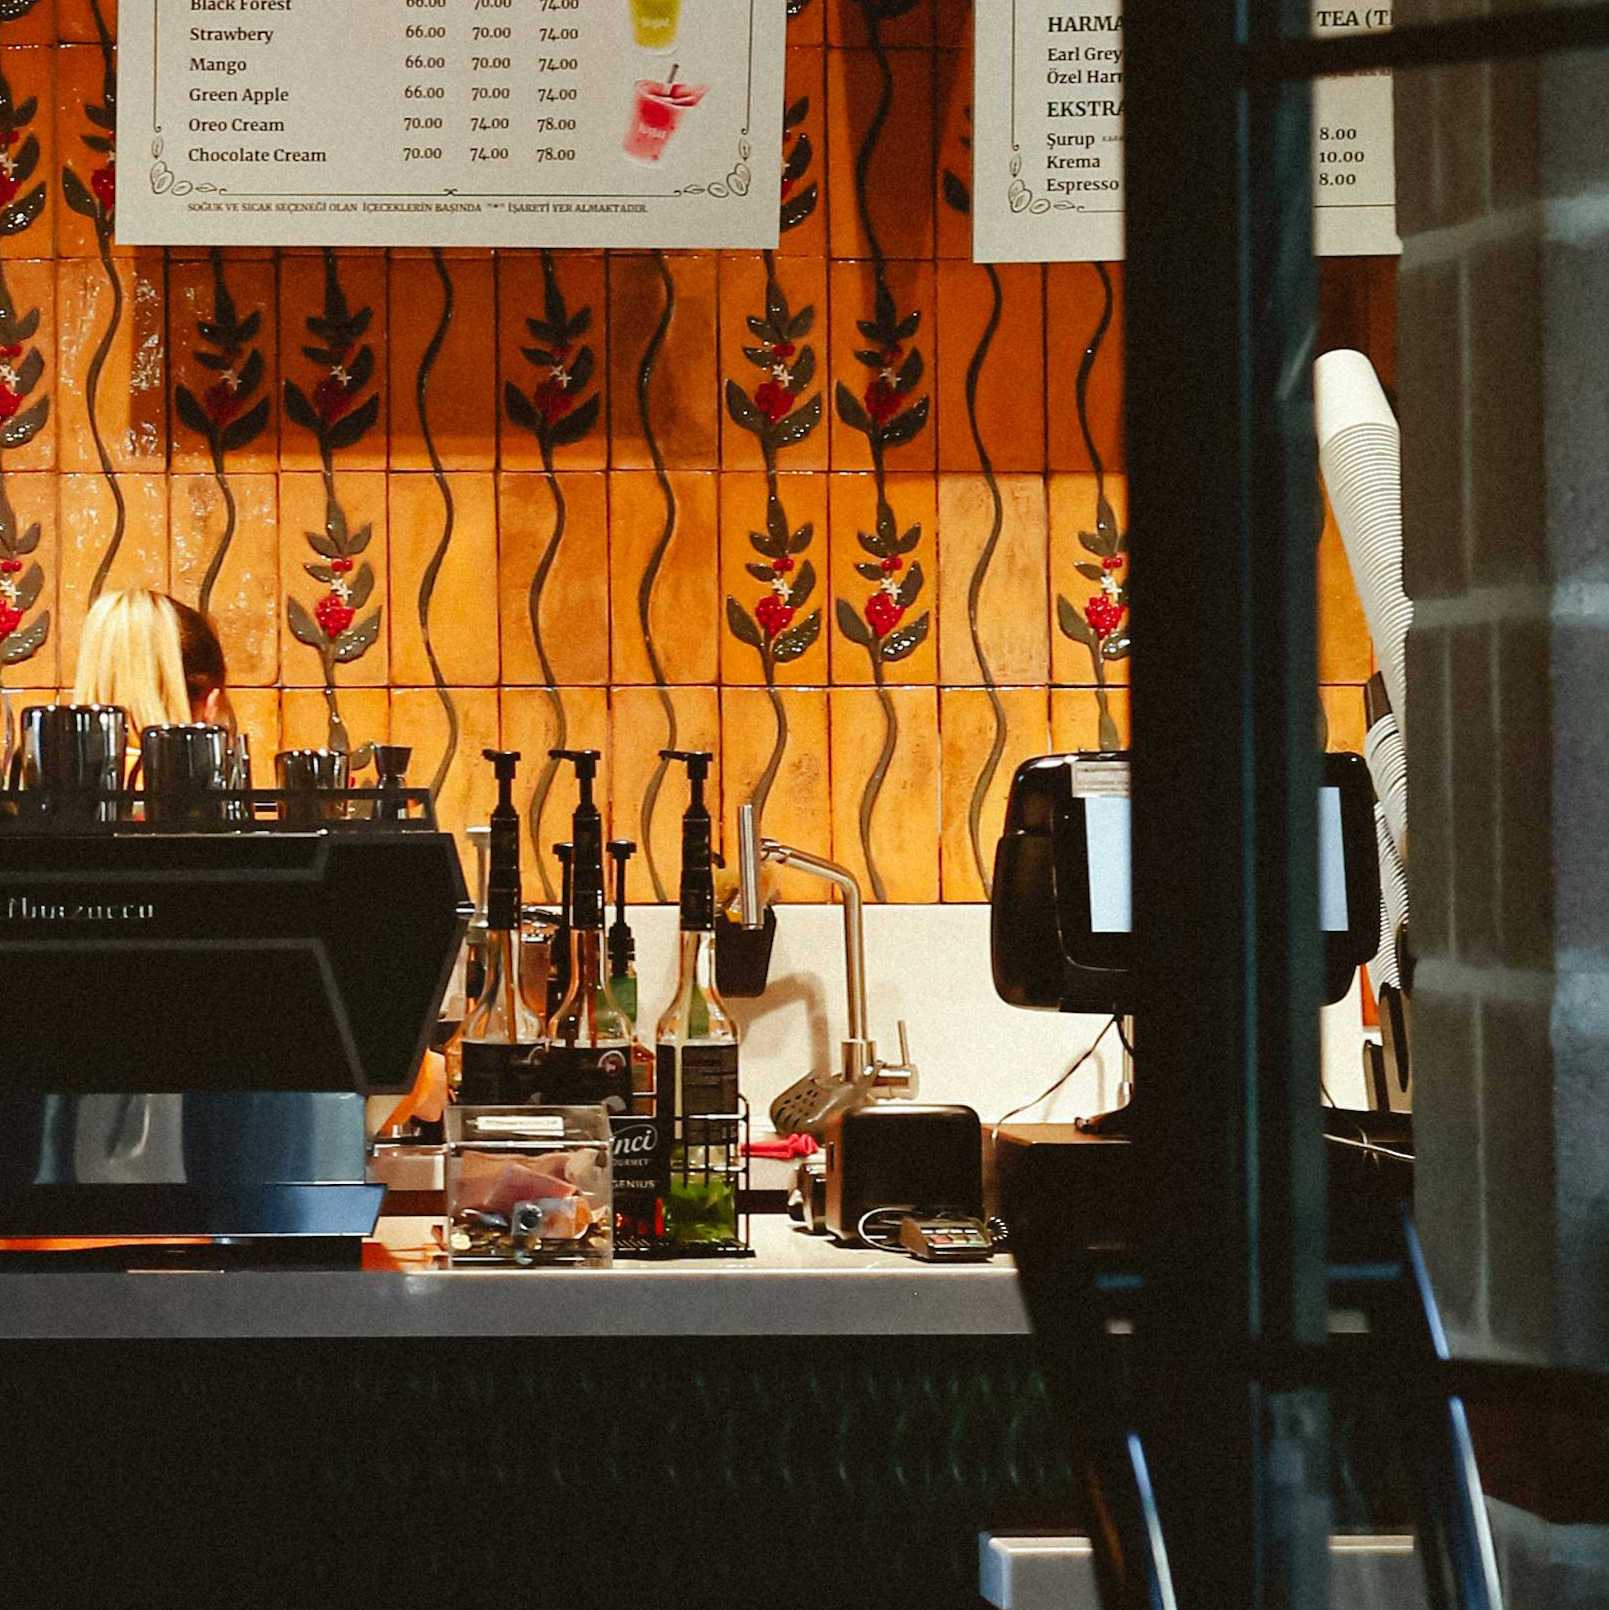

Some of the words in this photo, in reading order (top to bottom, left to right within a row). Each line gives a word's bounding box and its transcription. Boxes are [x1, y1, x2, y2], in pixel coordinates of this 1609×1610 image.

[1317, 11, 1360, 26] TEA
[190, 26, 274, 45] Strawbery
[1048, 47, 1079, 61] Earl
[1084, 47, 1121, 63] Grey
[190, 58, 247, 75] Mango
[1047, 68, 1082, 84] Özel
[189, 88, 237, 101] Green
[242, 87, 289, 105] Apple
[189, 118, 227, 132] Oreo
[231, 118, 284, 131] Cream
[1046, 133, 1095, 150] Şurup
[1320, 127, 1357, 141] 8.00
[188, 147, 270, 162] Chocolate
[273, 149, 326, 162] Cream
[403, 148, 442, 161] 70.00
[470, 147, 509, 162] 74.00
[537, 147, 575, 163] 78.00
[1046, 156, 1101, 169] Krema
[1319, 151, 1365, 163] 10.00
[1046, 179, 1119, 194] Espresso
